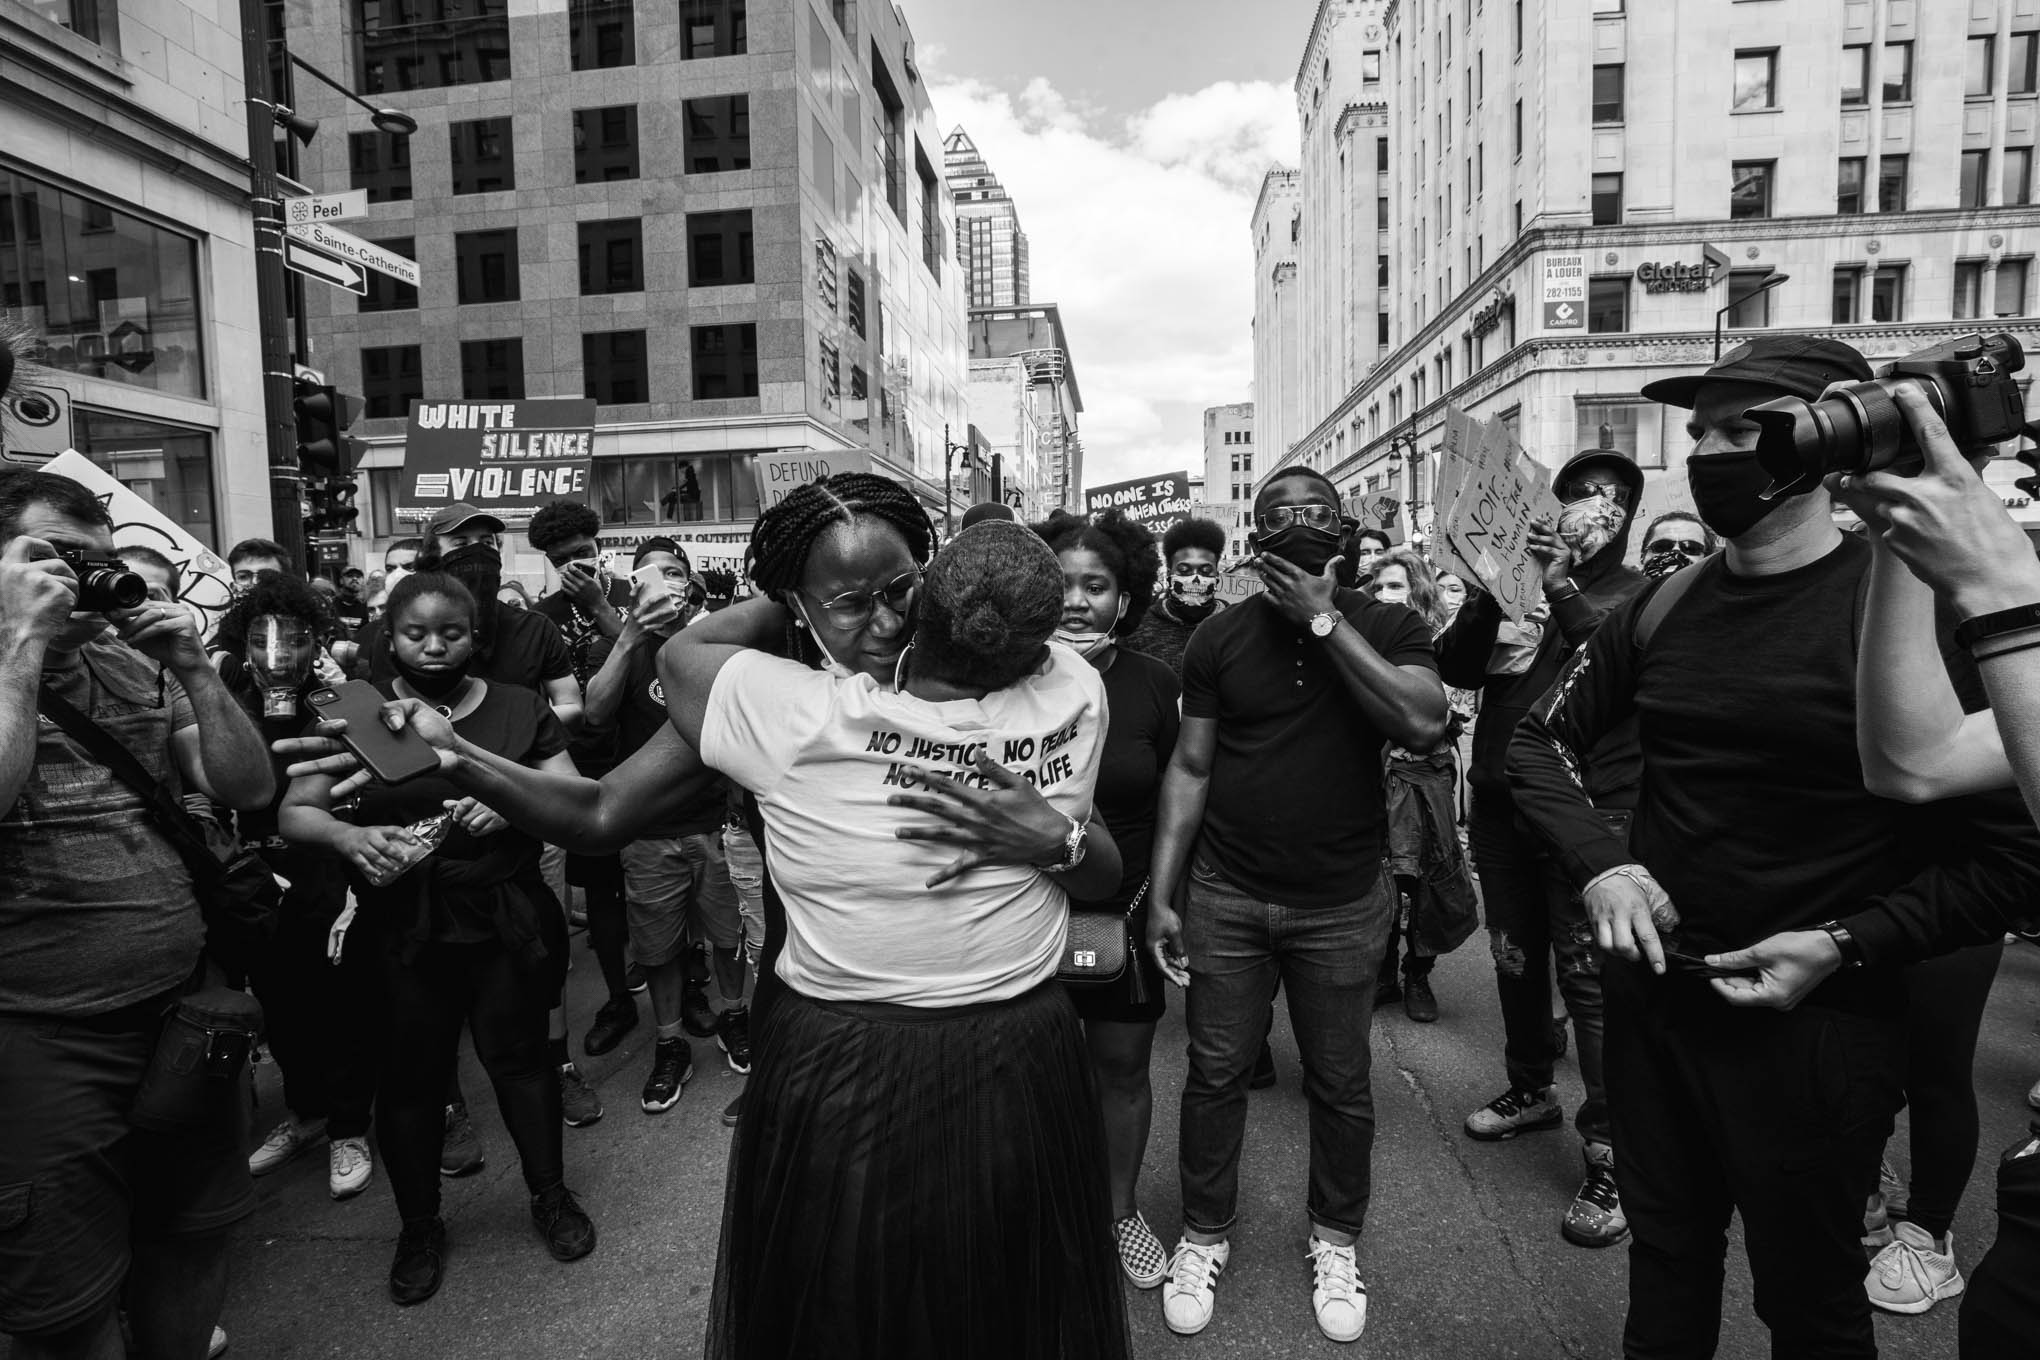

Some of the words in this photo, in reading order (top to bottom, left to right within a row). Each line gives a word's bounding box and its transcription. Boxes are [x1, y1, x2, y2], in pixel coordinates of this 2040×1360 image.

[313, 202, 342, 218] Peel
[314, 229, 415, 280] Sainte-Catherine
[1546, 257, 1582, 268] BUREAUX
[1555, 267, 1582, 278] LOUER
[1637, 261, 1708, 281] Global
[418, 404, 515, 429] WHITE
[480, 433, 589, 459] SILENCE
[769, 460, 830, 482] DEFUND
[1091, 494, 1113, 509] NO
[1114, 485, 1147, 505] ONE
[1151, 480, 1175, 497] IS
[1124, 501, 1158, 521] WHEN
[1340, 496, 1370, 518] ACK
[695, 532, 752, 544] OUTFITT
[1491, 525, 1508, 549] UN
[1501, 501, 1531, 562] HUMAIN
[1223, 575, 1266, 597] JUSTIC
[1499, 546, 1534, 605] COMM
[865, 731, 902, 755] NO
[1003, 737, 1035, 765] NO
[1040, 718, 1078, 760] PEACE
[1039, 753, 1074, 790] LIFE
